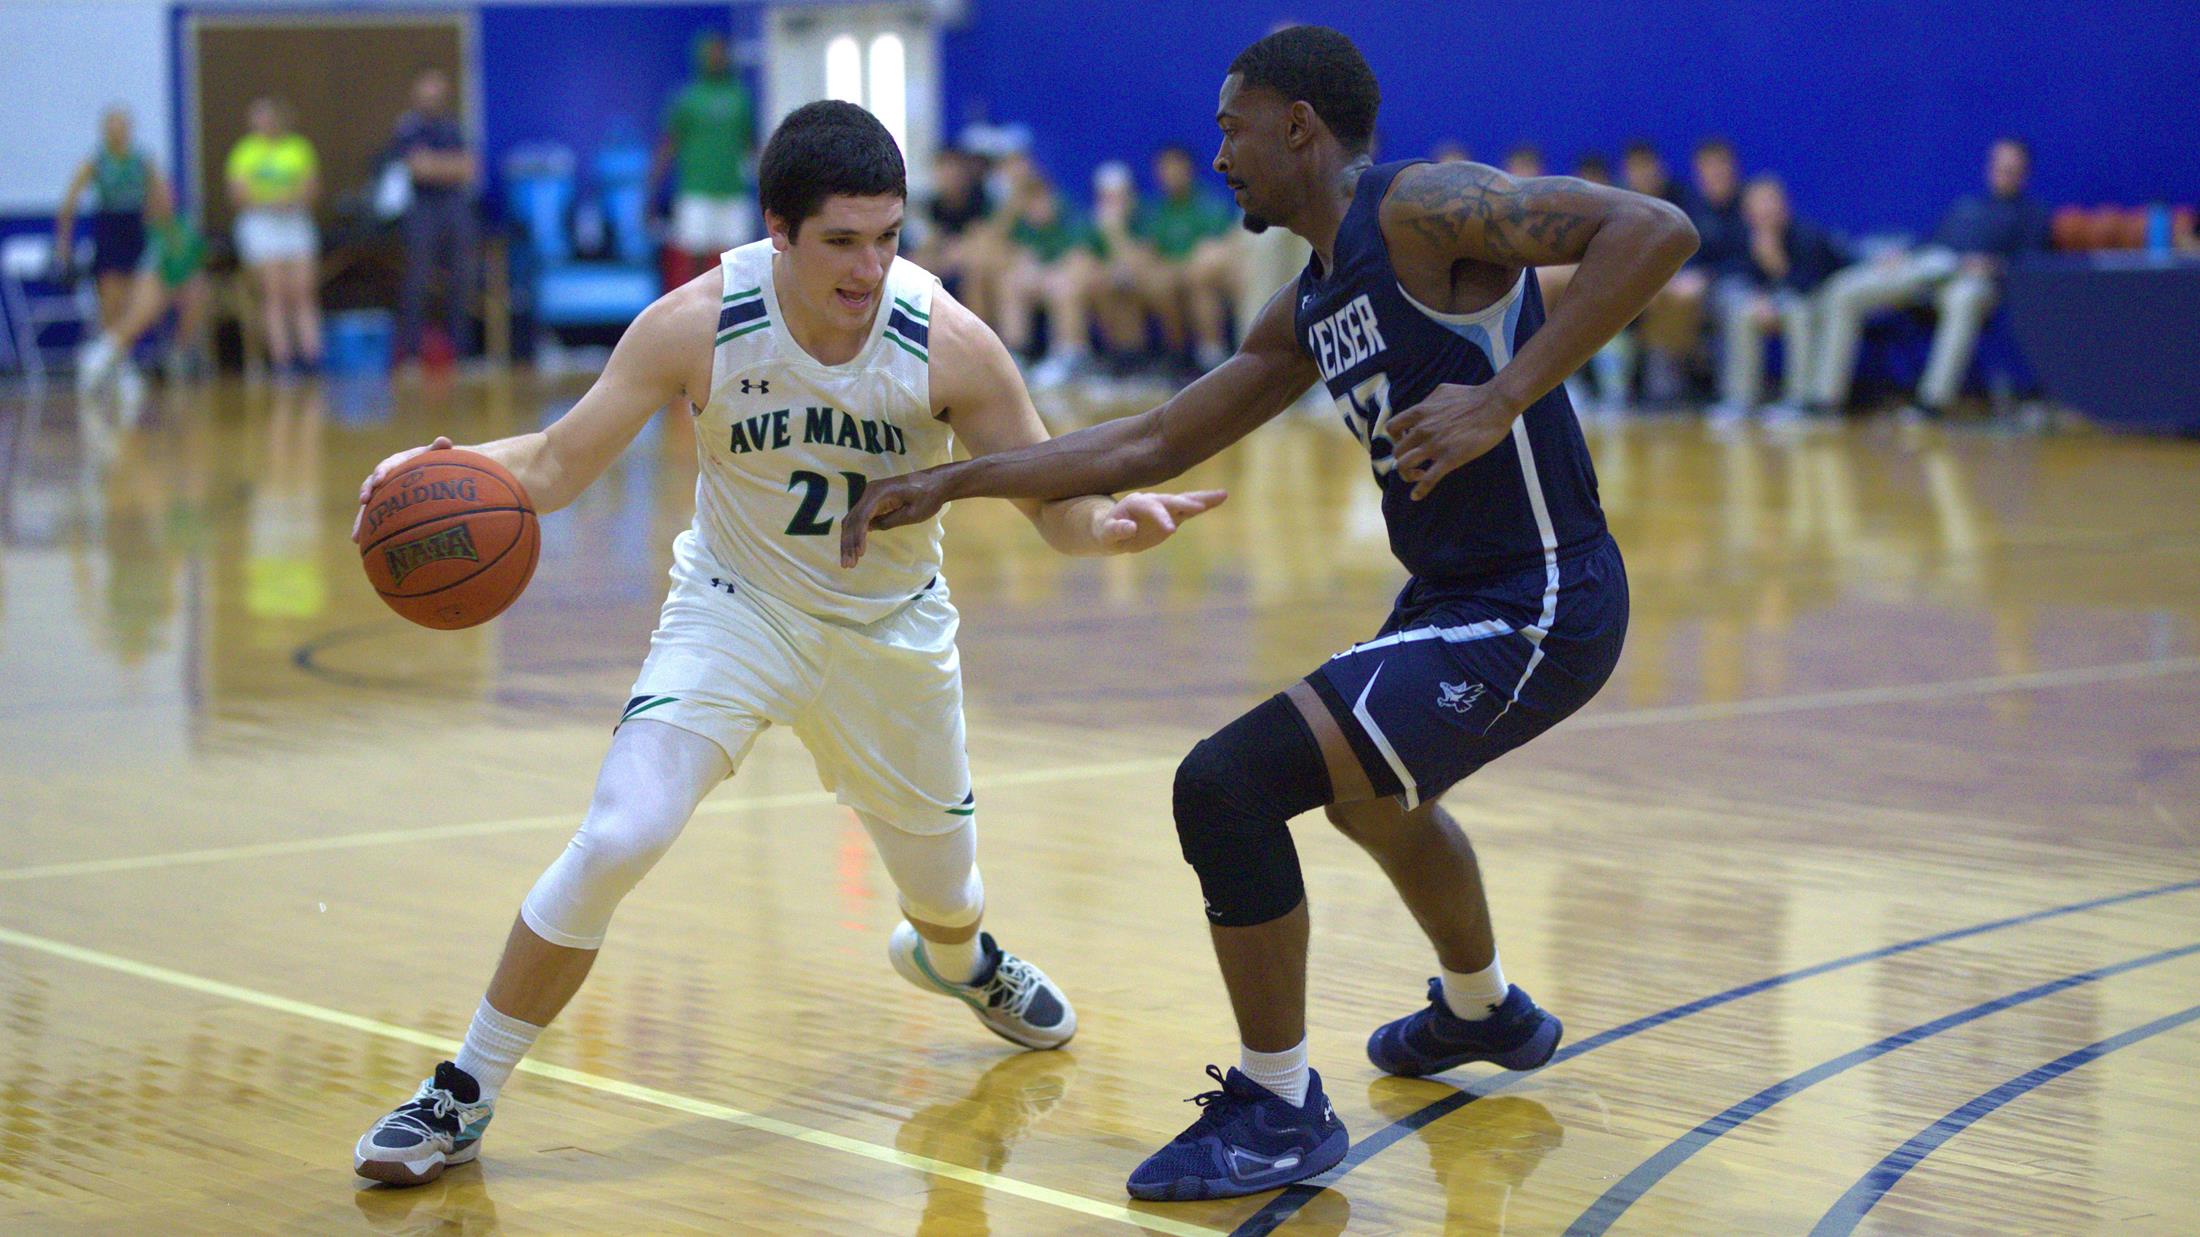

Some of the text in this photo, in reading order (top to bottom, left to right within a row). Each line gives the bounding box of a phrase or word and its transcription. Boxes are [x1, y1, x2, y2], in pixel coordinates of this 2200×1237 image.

[1308, 293, 1387, 383] EISER
[729, 408, 792, 454] AVE
[367, 477, 477, 535] SPALDING
